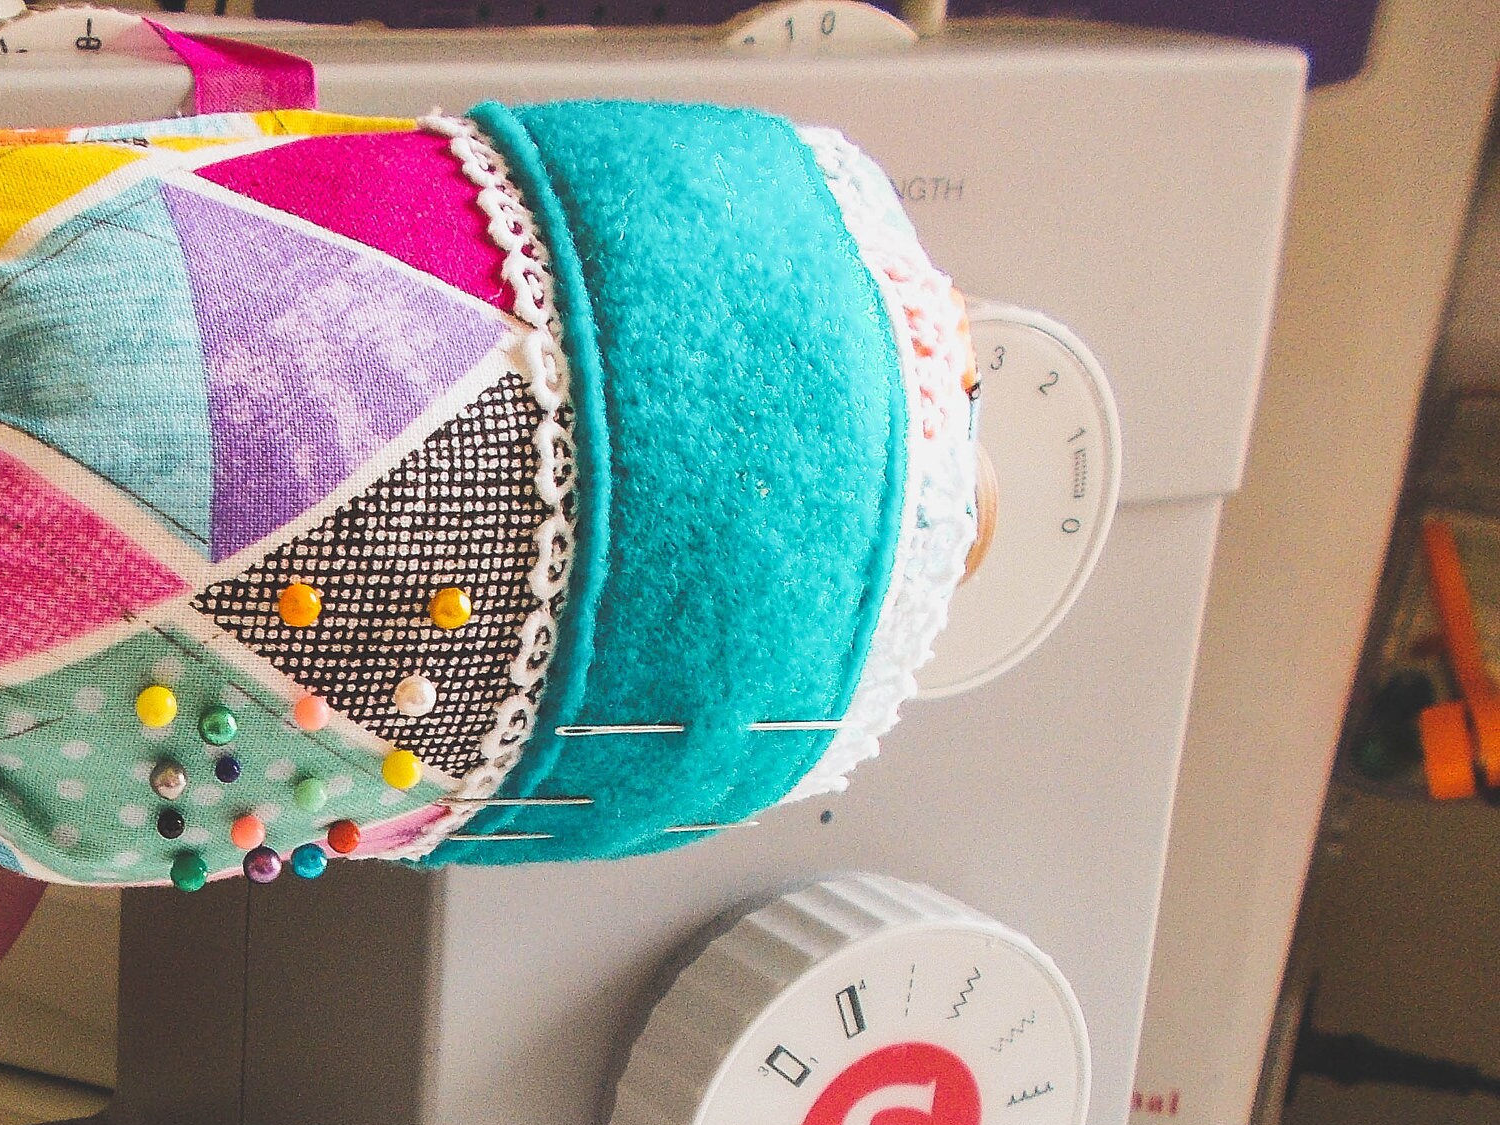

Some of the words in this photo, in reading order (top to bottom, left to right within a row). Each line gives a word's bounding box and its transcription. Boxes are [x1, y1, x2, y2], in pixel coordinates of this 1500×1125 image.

[785, 16, 794, 40] 1
[820, 10, 836, 36] 0
[890, 175, 964, 201] NGTH
[990, 345, 1006, 371] 3
[1038, 370, 1060, 396] 2
[1066, 426, 1087, 443] 1
[1060, 517, 1081, 535] 0
[757, 1064, 771, 1078] 3
